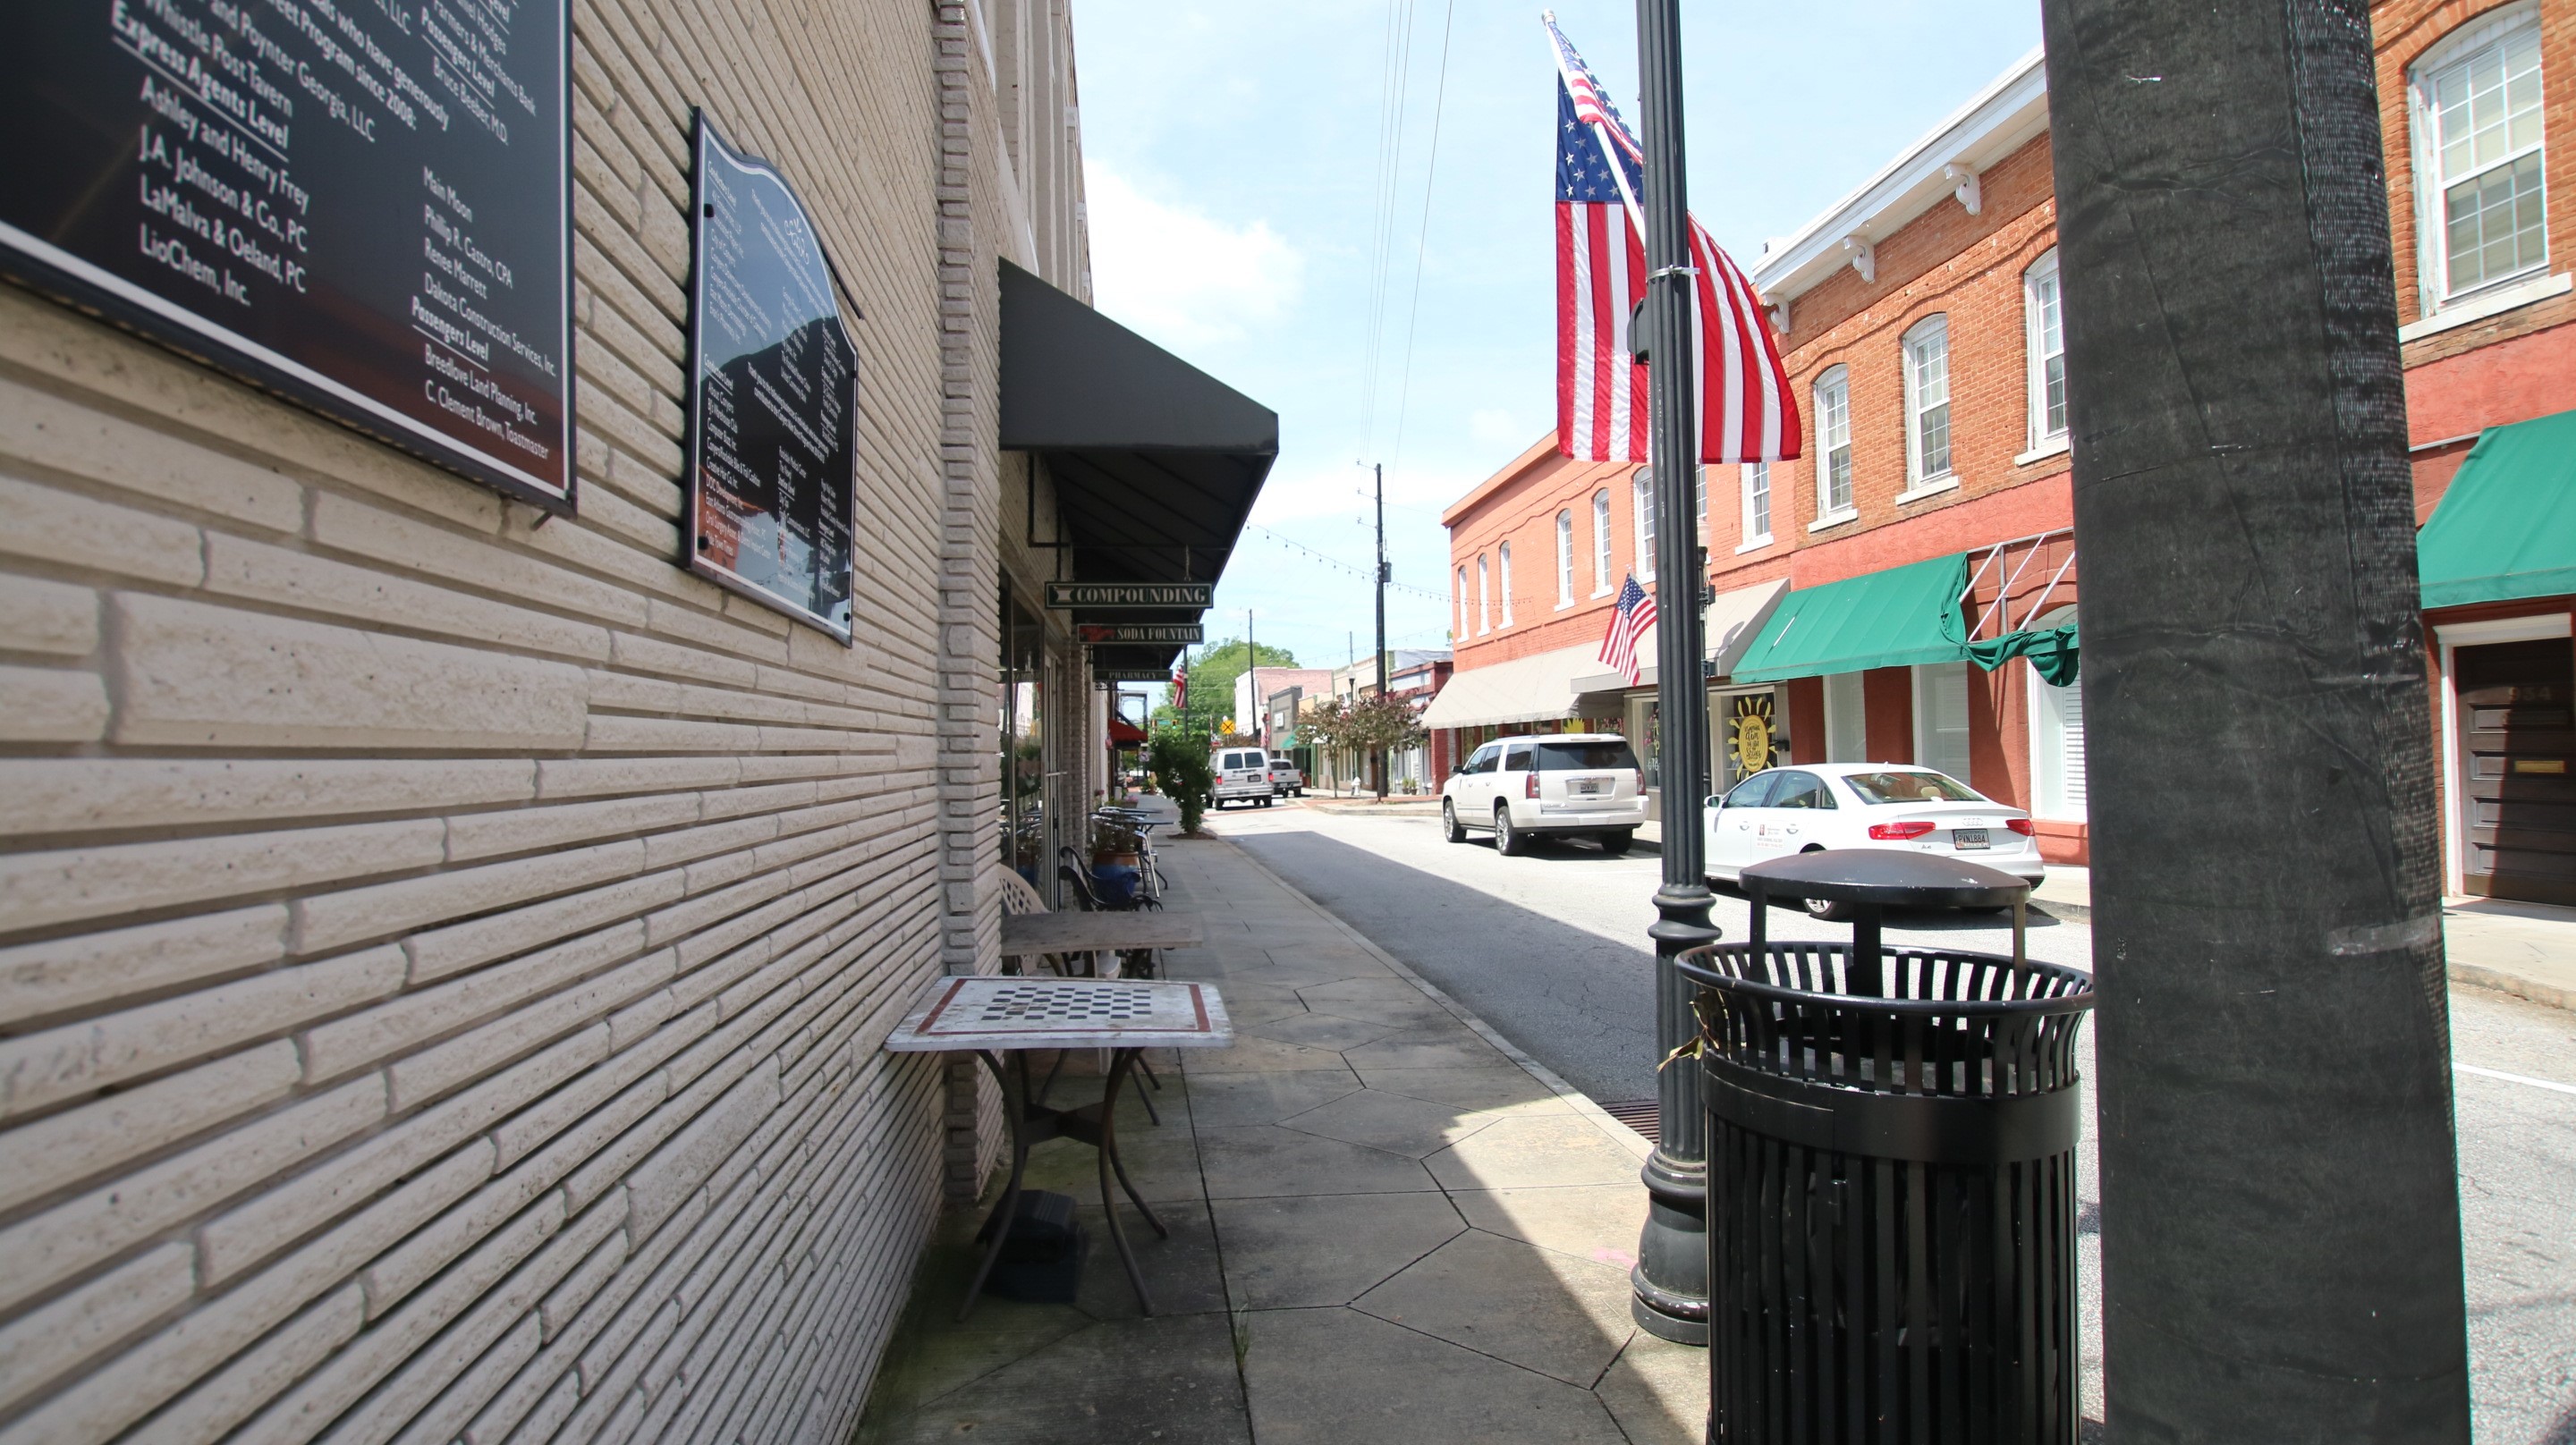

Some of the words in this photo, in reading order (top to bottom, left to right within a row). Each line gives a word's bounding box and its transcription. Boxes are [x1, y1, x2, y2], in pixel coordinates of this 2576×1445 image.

[249, 98, 289, 149] Level
[1076, 587, 1206, 604] COMPOUNDING
[1117, 627, 1145, 640] SODA
[1148, 627, 1200, 640] FOUNTAIN
[1108, 672, 1157, 680] PHARMACY
